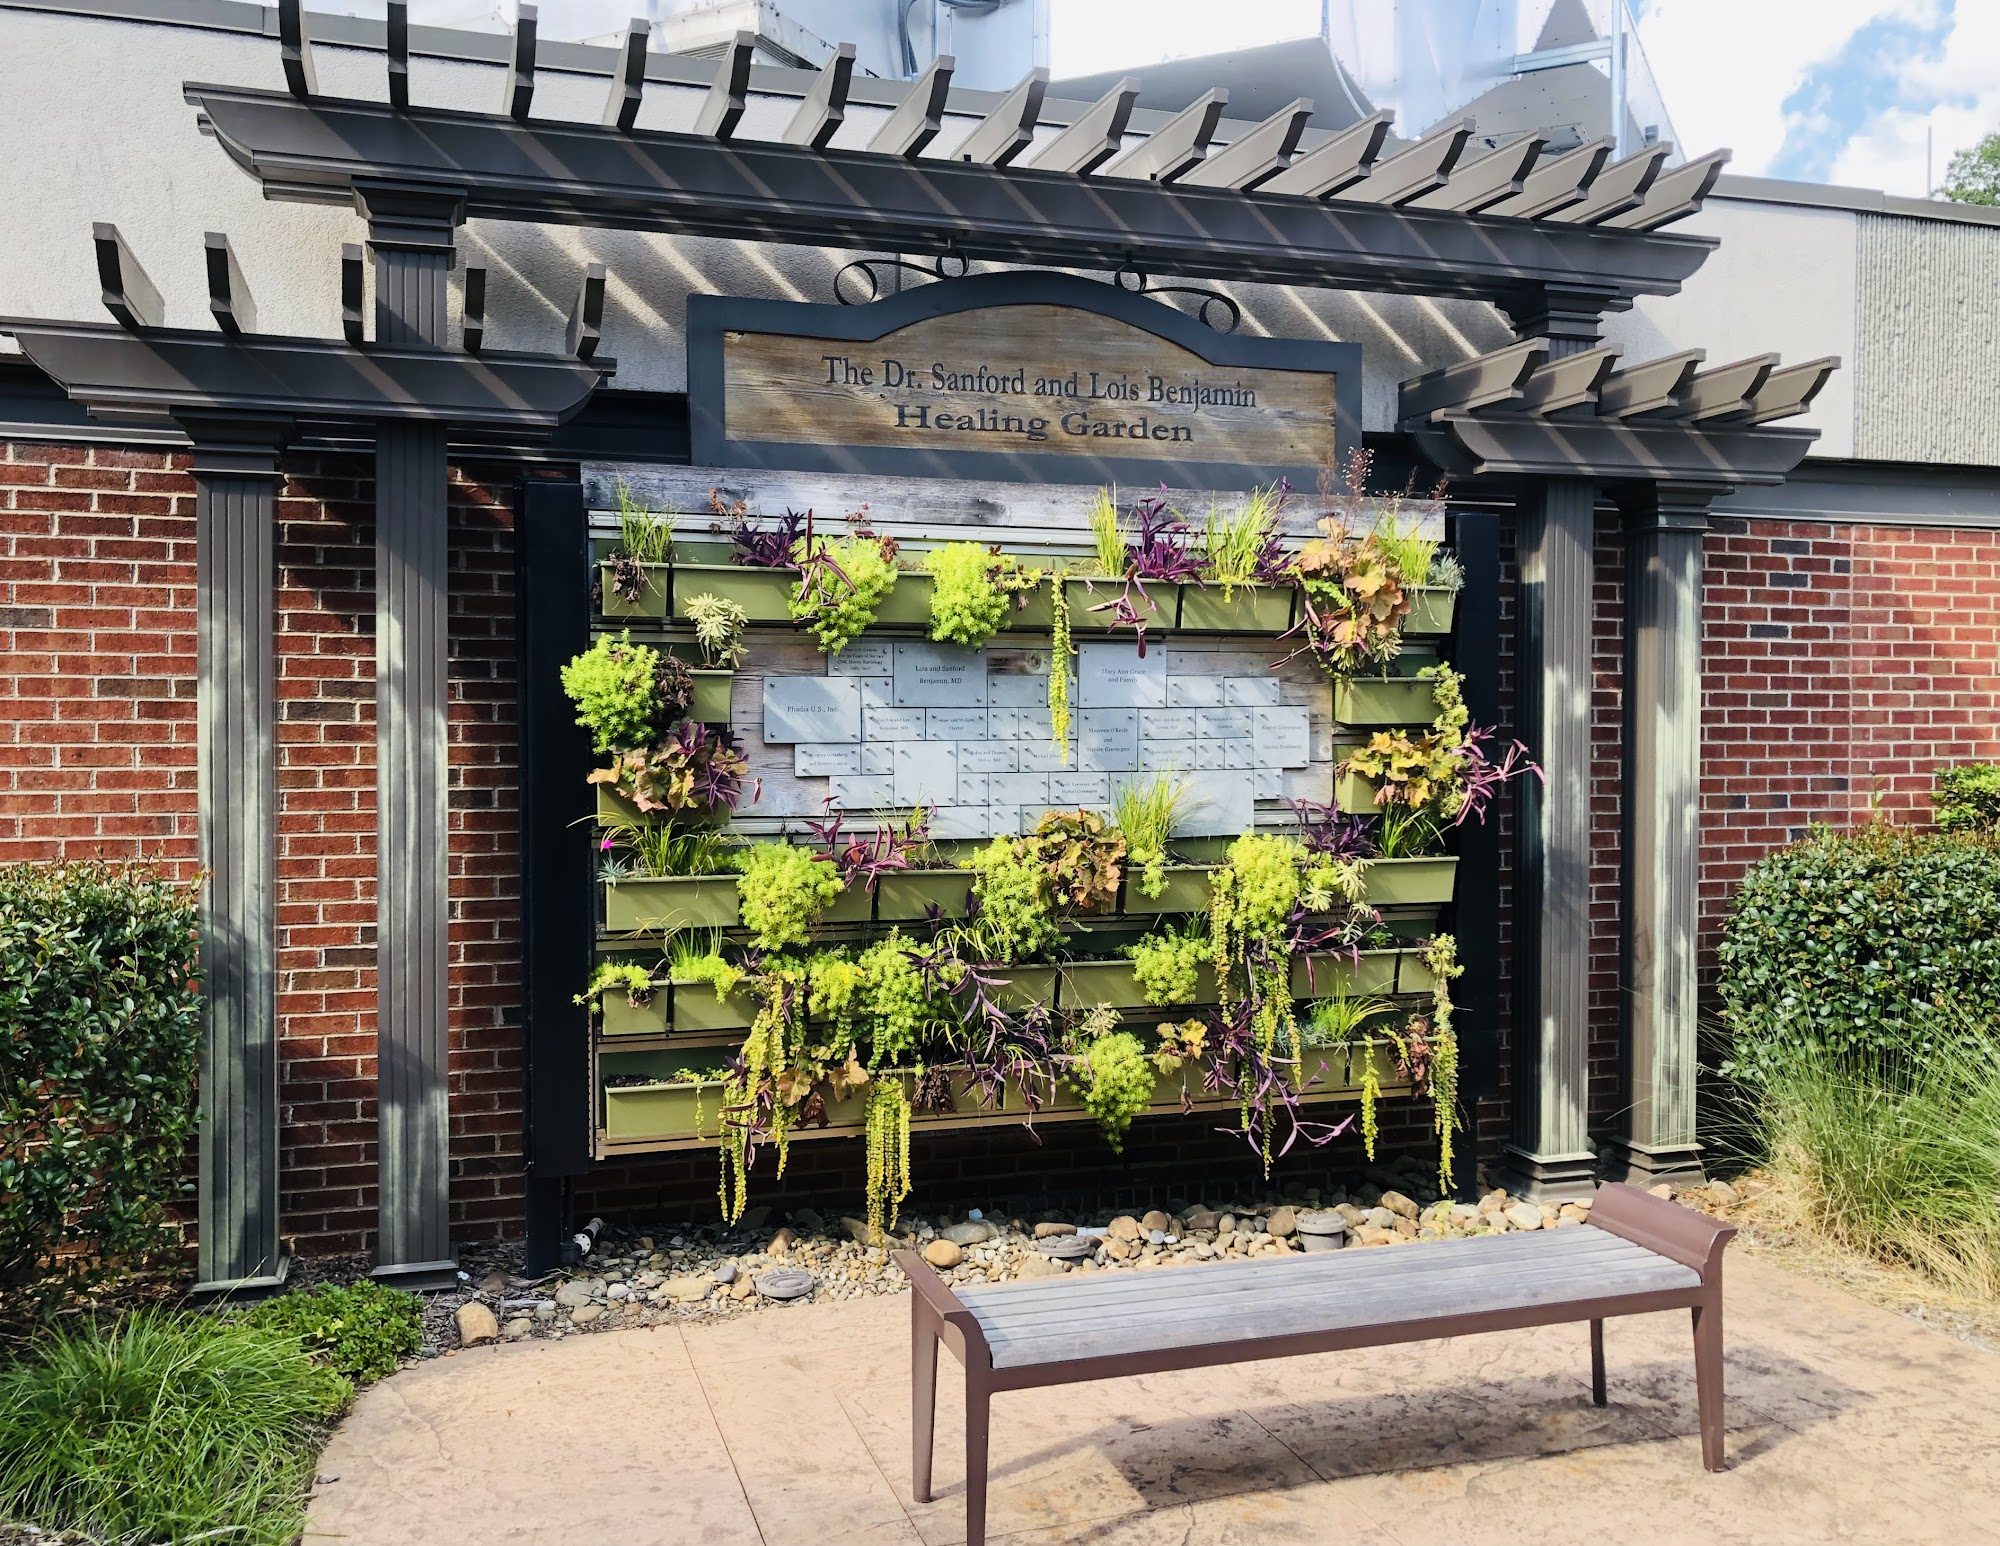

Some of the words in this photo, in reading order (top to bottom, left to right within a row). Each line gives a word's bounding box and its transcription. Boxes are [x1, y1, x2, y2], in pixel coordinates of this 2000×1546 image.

[821, 355, 874, 385] The
[882, 359, 922, 389] Dr.
[931, 362, 1026, 395] Sanford
[1034, 372, 1078, 397] and
[1089, 372, 1139, 401] Lois
[1147, 375, 1257, 412] Benjamin
[893, 404, 1051, 441] Healing
[1060, 411, 1194, 442] Garden
[1101, 668, 1116, 676] Mary
[919, 677, 950, 686] Benjamin,
[1120, 676, 1138, 685] Family
[787, 705, 809, 713] Phadia
